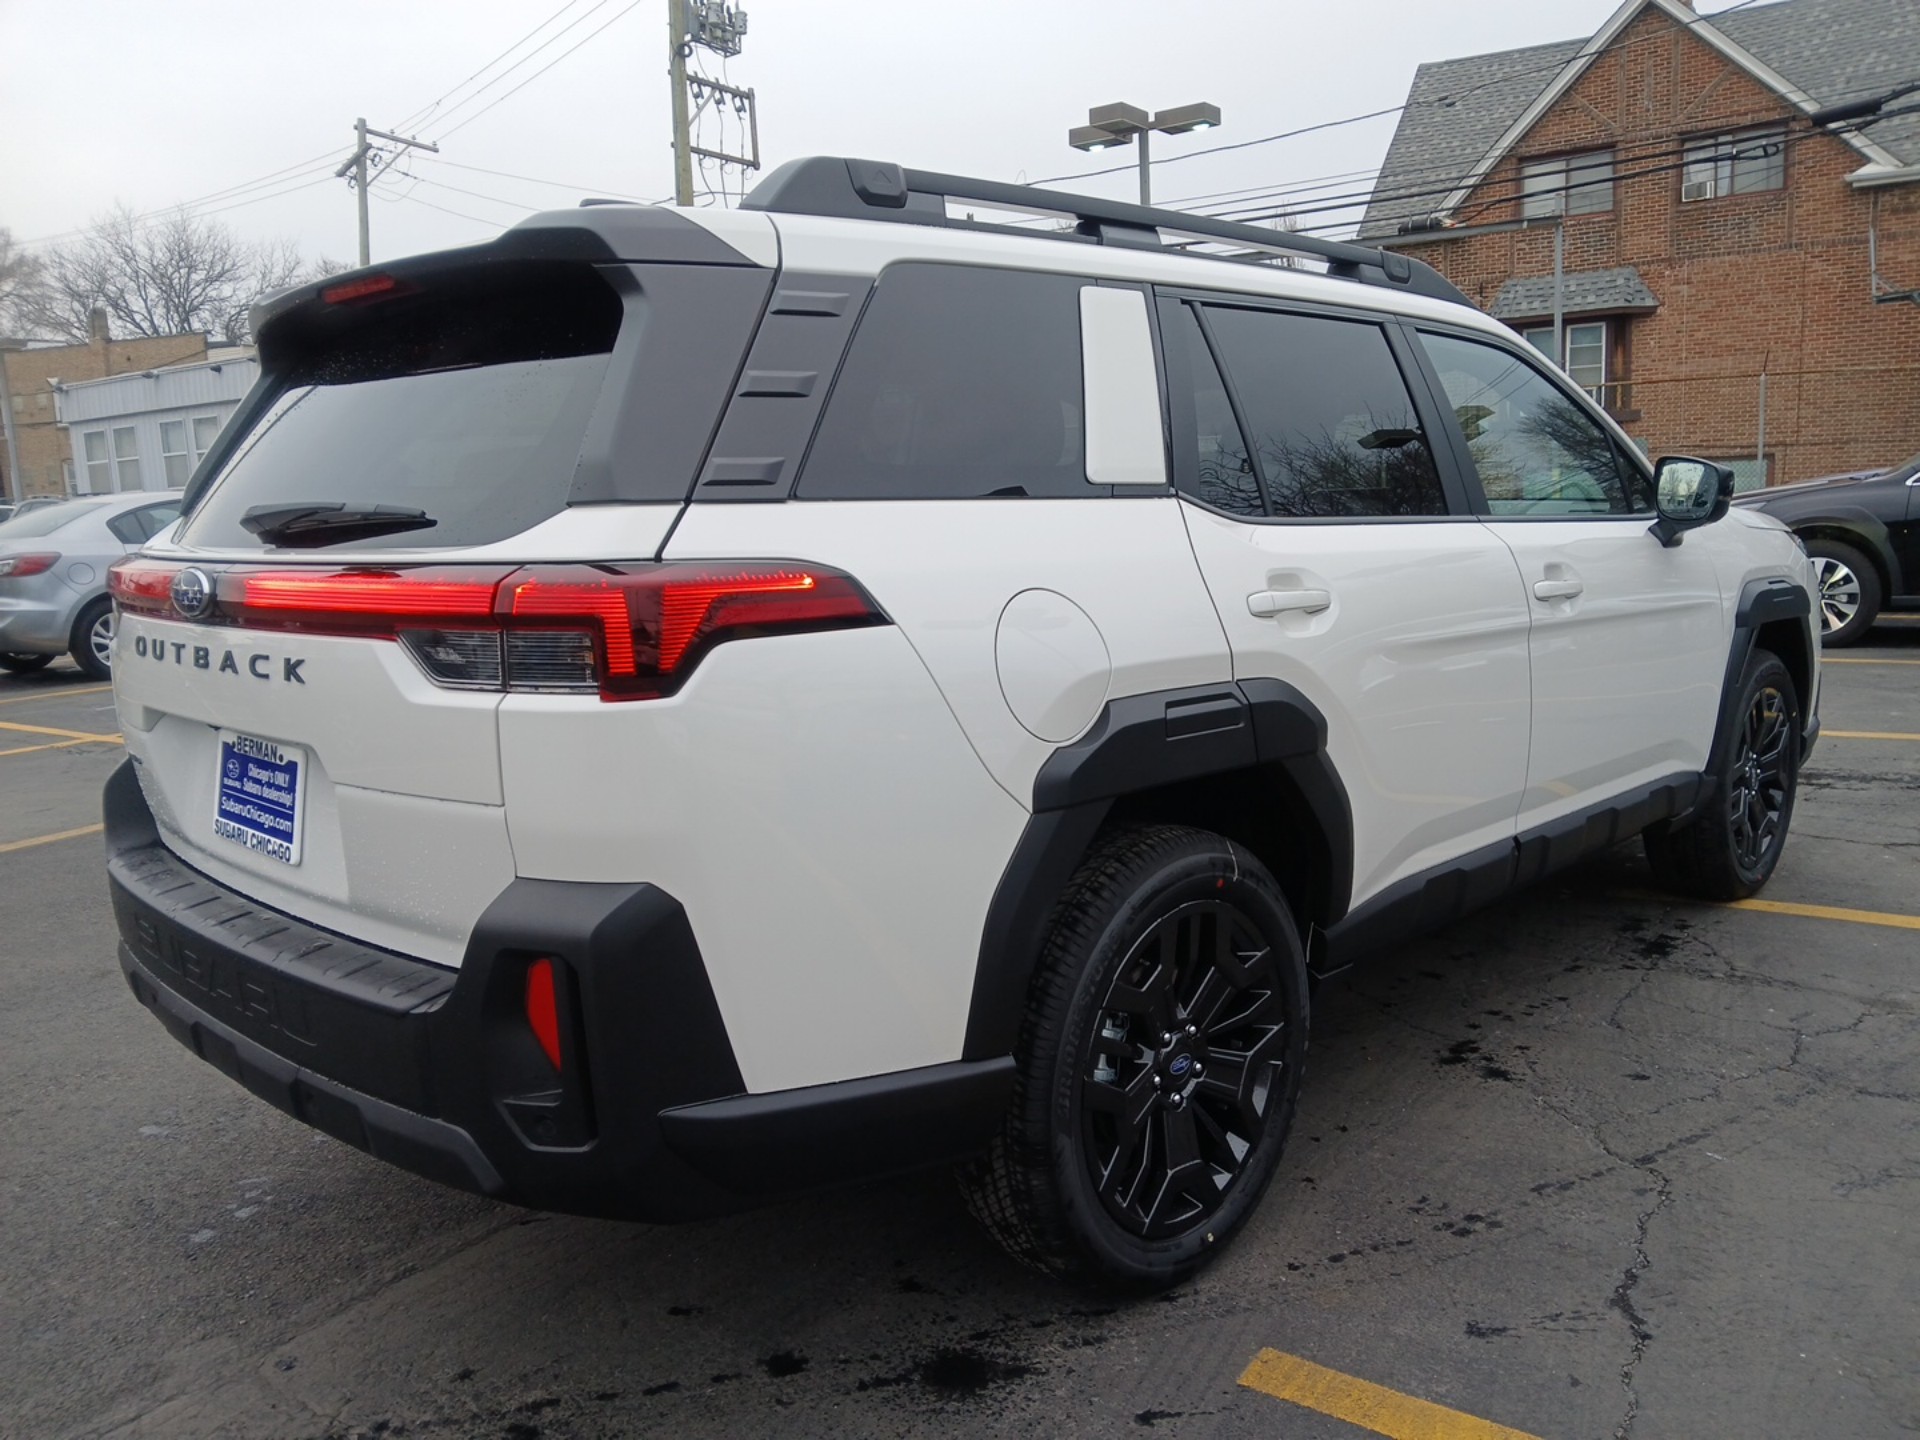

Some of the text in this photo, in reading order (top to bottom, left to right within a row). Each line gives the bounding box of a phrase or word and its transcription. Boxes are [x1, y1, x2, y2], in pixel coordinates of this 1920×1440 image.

[135, 635, 306, 684] OUTBACK
[236, 735, 278, 763] BERMAN
[221, 796, 292, 834] SubaruChicago.com
[214, 818, 292, 863] SUBARU CHICAGO
